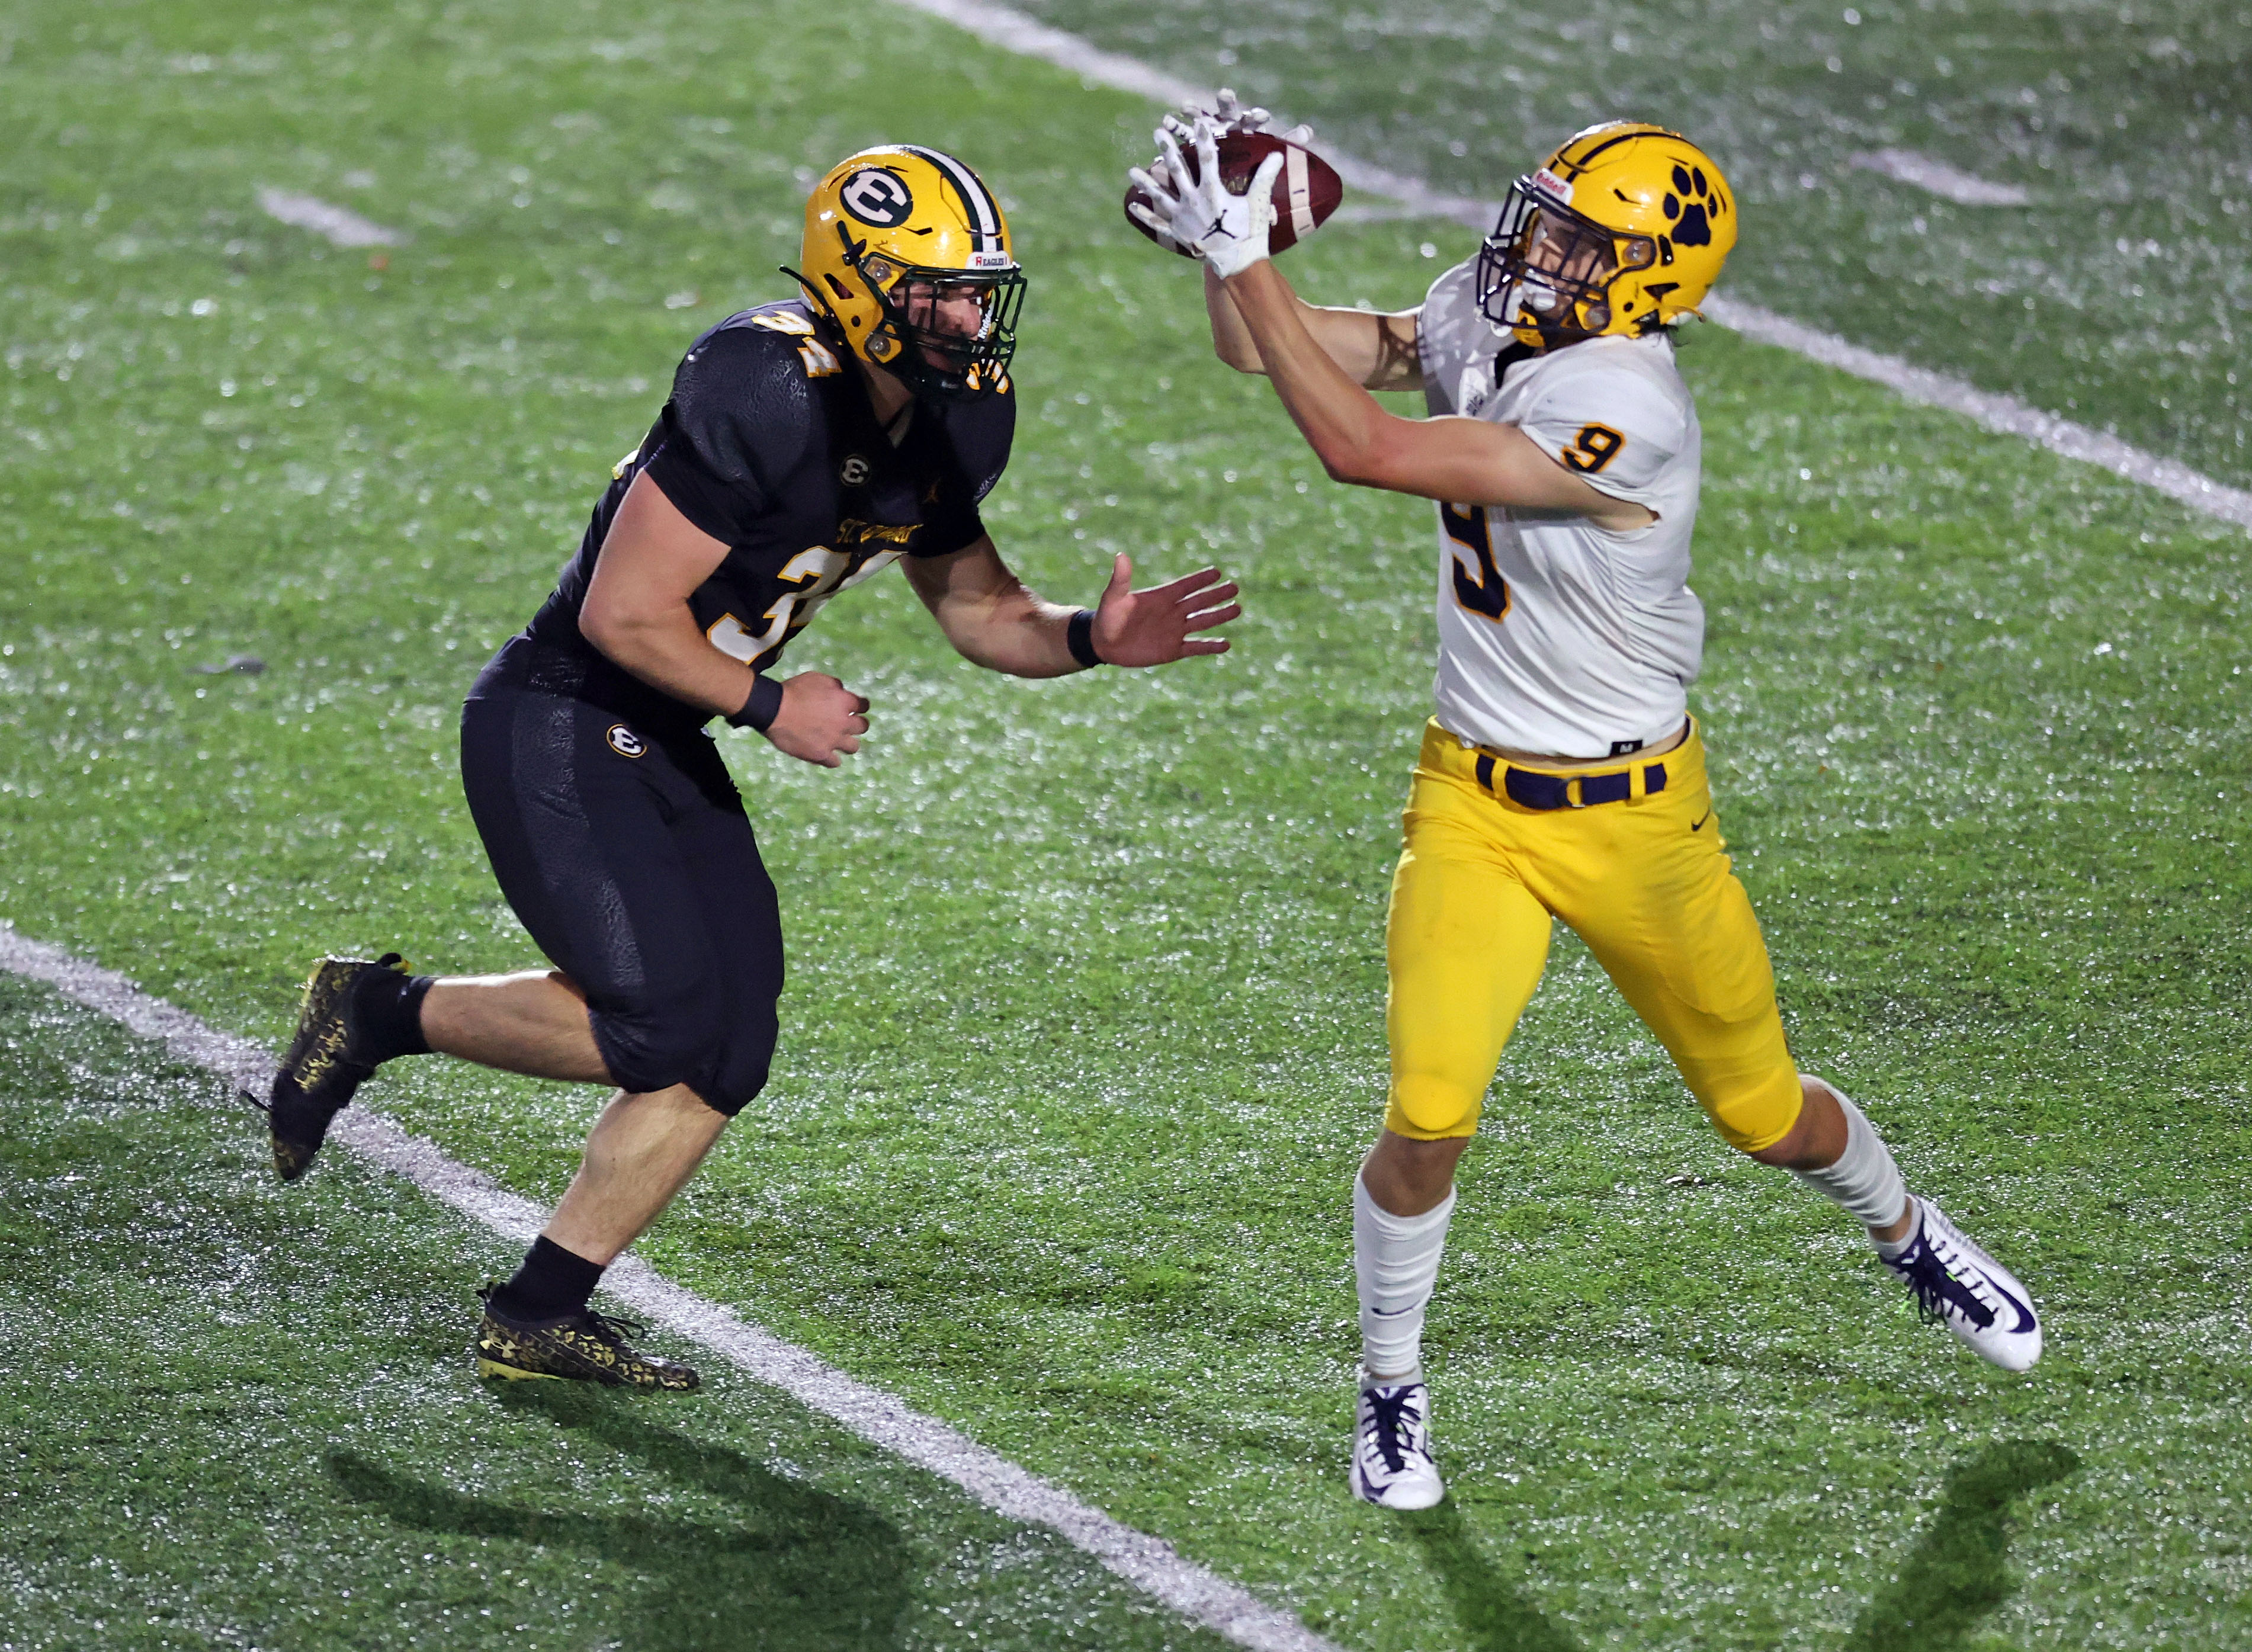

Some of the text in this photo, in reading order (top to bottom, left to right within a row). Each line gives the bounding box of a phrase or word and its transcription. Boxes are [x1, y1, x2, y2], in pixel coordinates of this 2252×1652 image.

[843, 171, 907, 223] E
[1561, 422, 1627, 473] 9
[1441, 501, 1512, 624] 9
